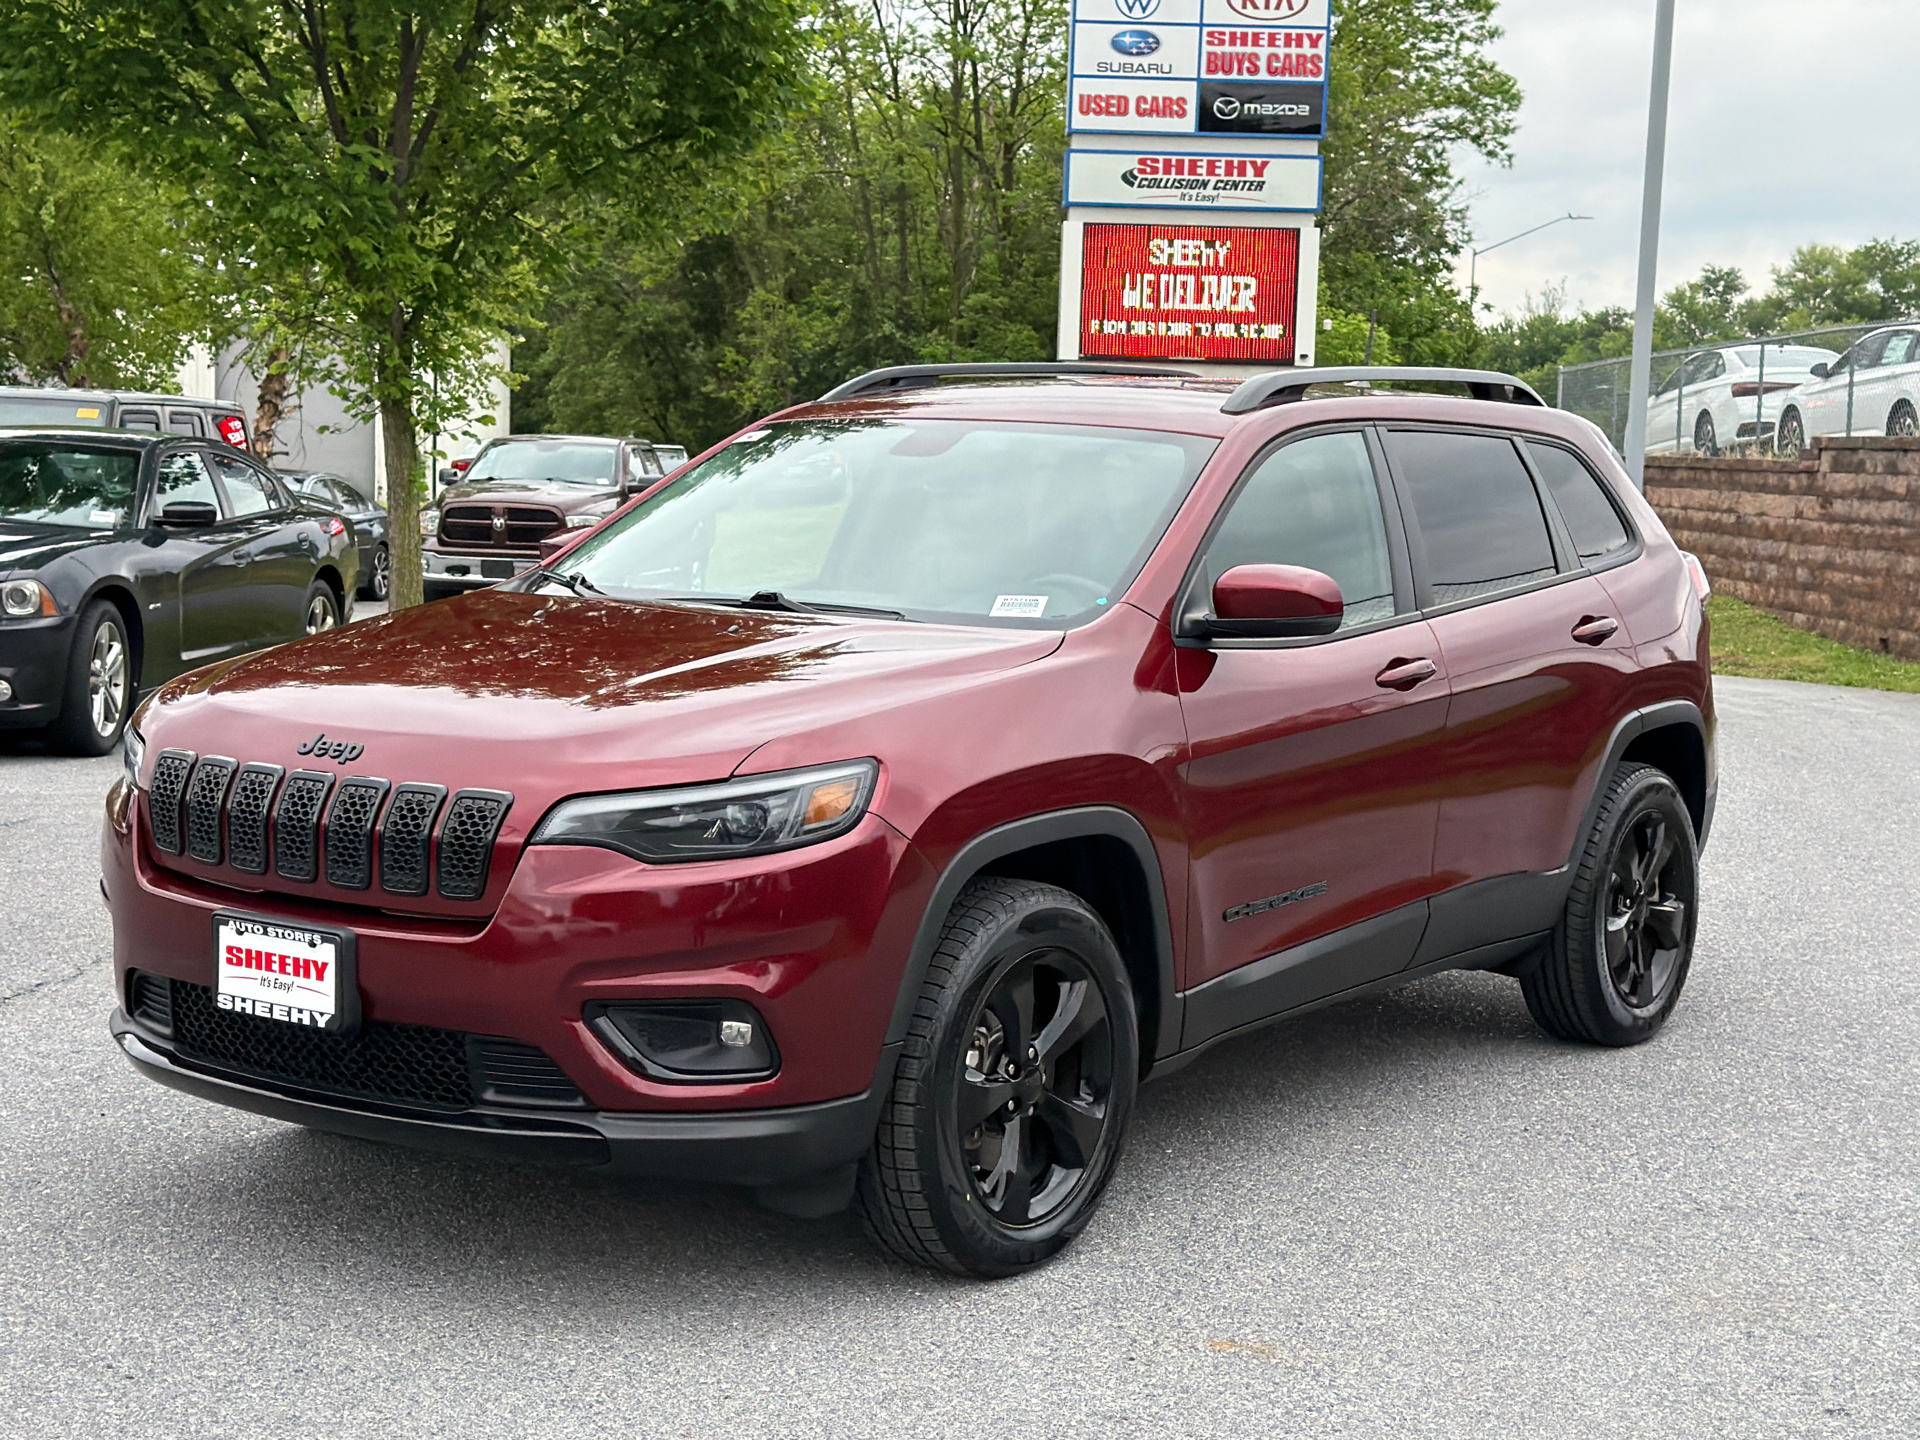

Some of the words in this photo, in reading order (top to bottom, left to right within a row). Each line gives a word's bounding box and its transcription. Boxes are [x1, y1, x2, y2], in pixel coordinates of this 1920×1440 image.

[1205, 30, 1325, 49] SHEEHY
[1096, 61, 1173, 75] SUBARU
[1206, 51, 1261, 77] BUYS
[1266, 52, 1324, 78] CARS
[1078, 93, 1129, 117] USED
[1135, 95, 1188, 119] CARS
[1137, 157, 1270, 178] SHEEHY
[1137, 177, 1210, 191] COLLISION
[1212, 179, 1266, 192] CENTER
[1179, 191, 1193, 202] It's
[1195, 192, 1220, 204] Easy!
[1149, 238, 1231, 267] SHEEHY
[1123, 272, 1155, 309] WE
[297, 733, 364, 765] Jeep
[228, 920, 264, 935] AUTO
[267, 926, 322, 945] STORES
[225, 945, 329, 982] SHEEHY
[260, 975, 271, 988] It's
[273, 978, 295, 994] Easy!
[217, 993, 332, 1028] SHEEHY
